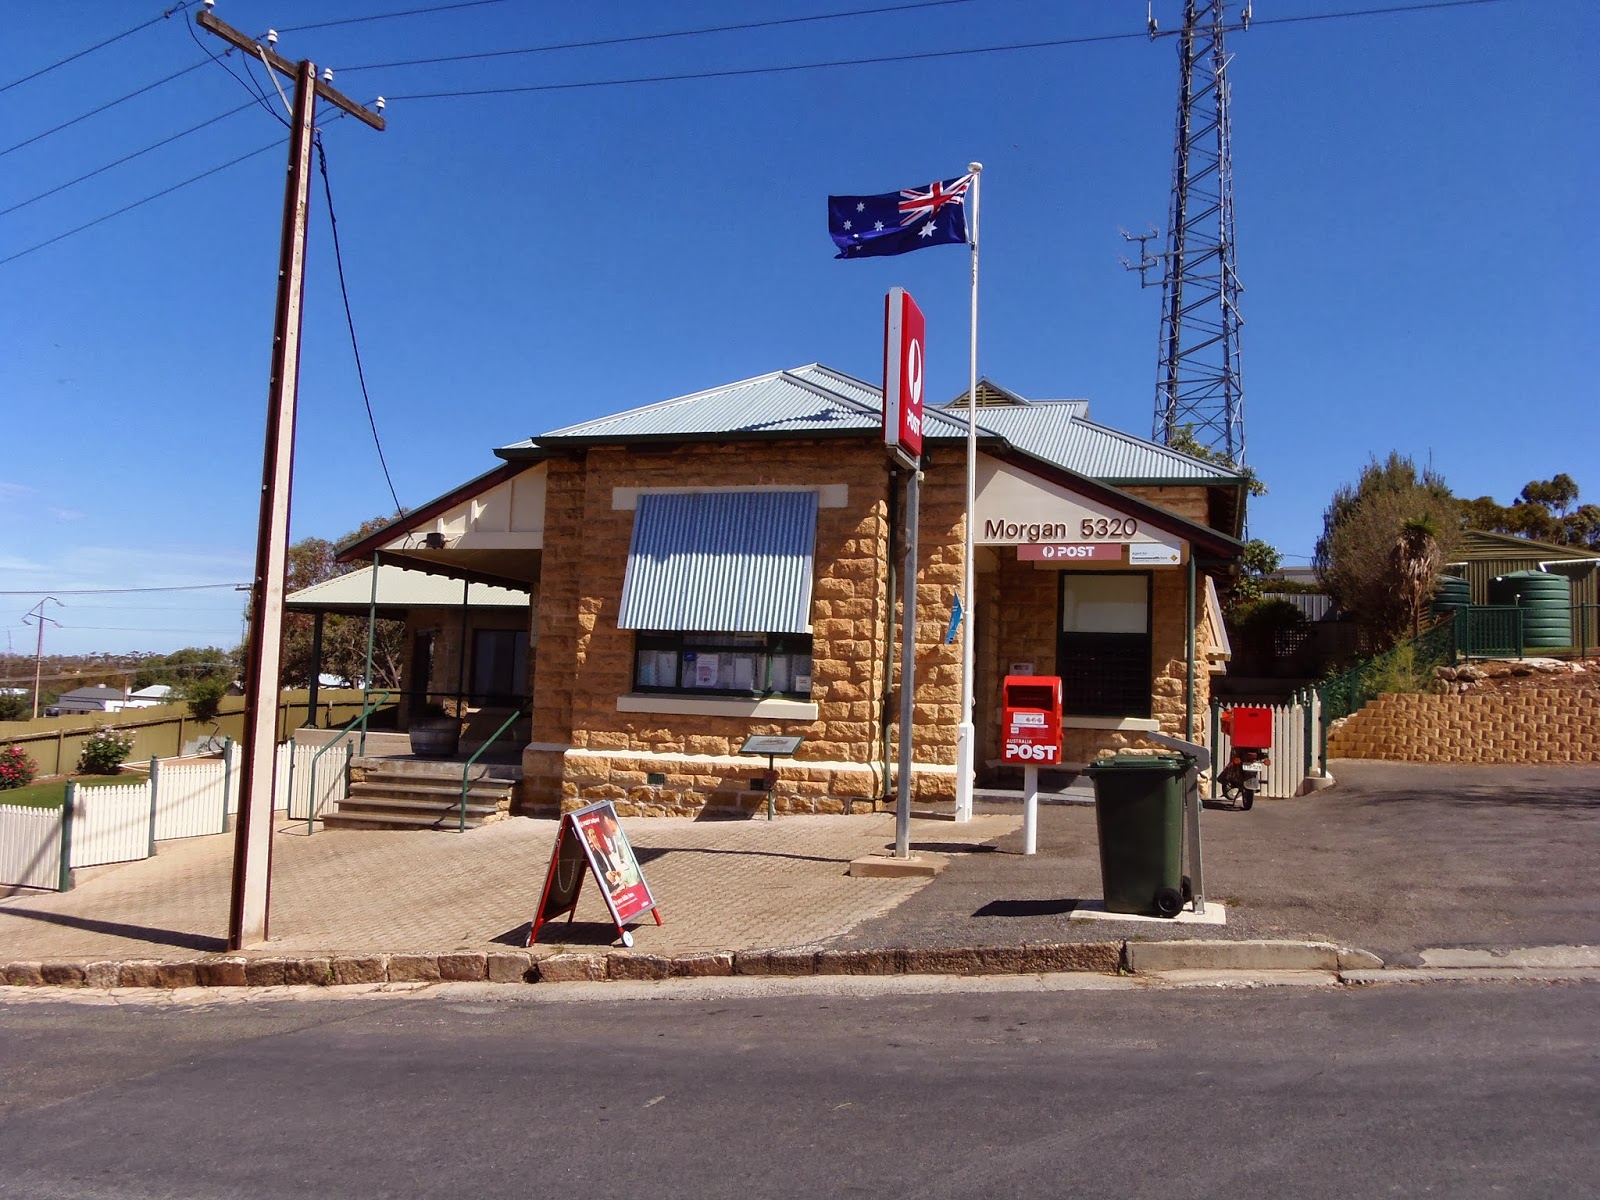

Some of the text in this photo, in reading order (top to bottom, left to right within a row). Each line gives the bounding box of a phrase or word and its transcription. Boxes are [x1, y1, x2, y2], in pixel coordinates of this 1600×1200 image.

[907, 408, 921, 437] POST
[985, 518, 1138, 542] Morgan 5320
[1057, 546, 1095, 557] POST
[1006, 743, 1058, 760] POST
